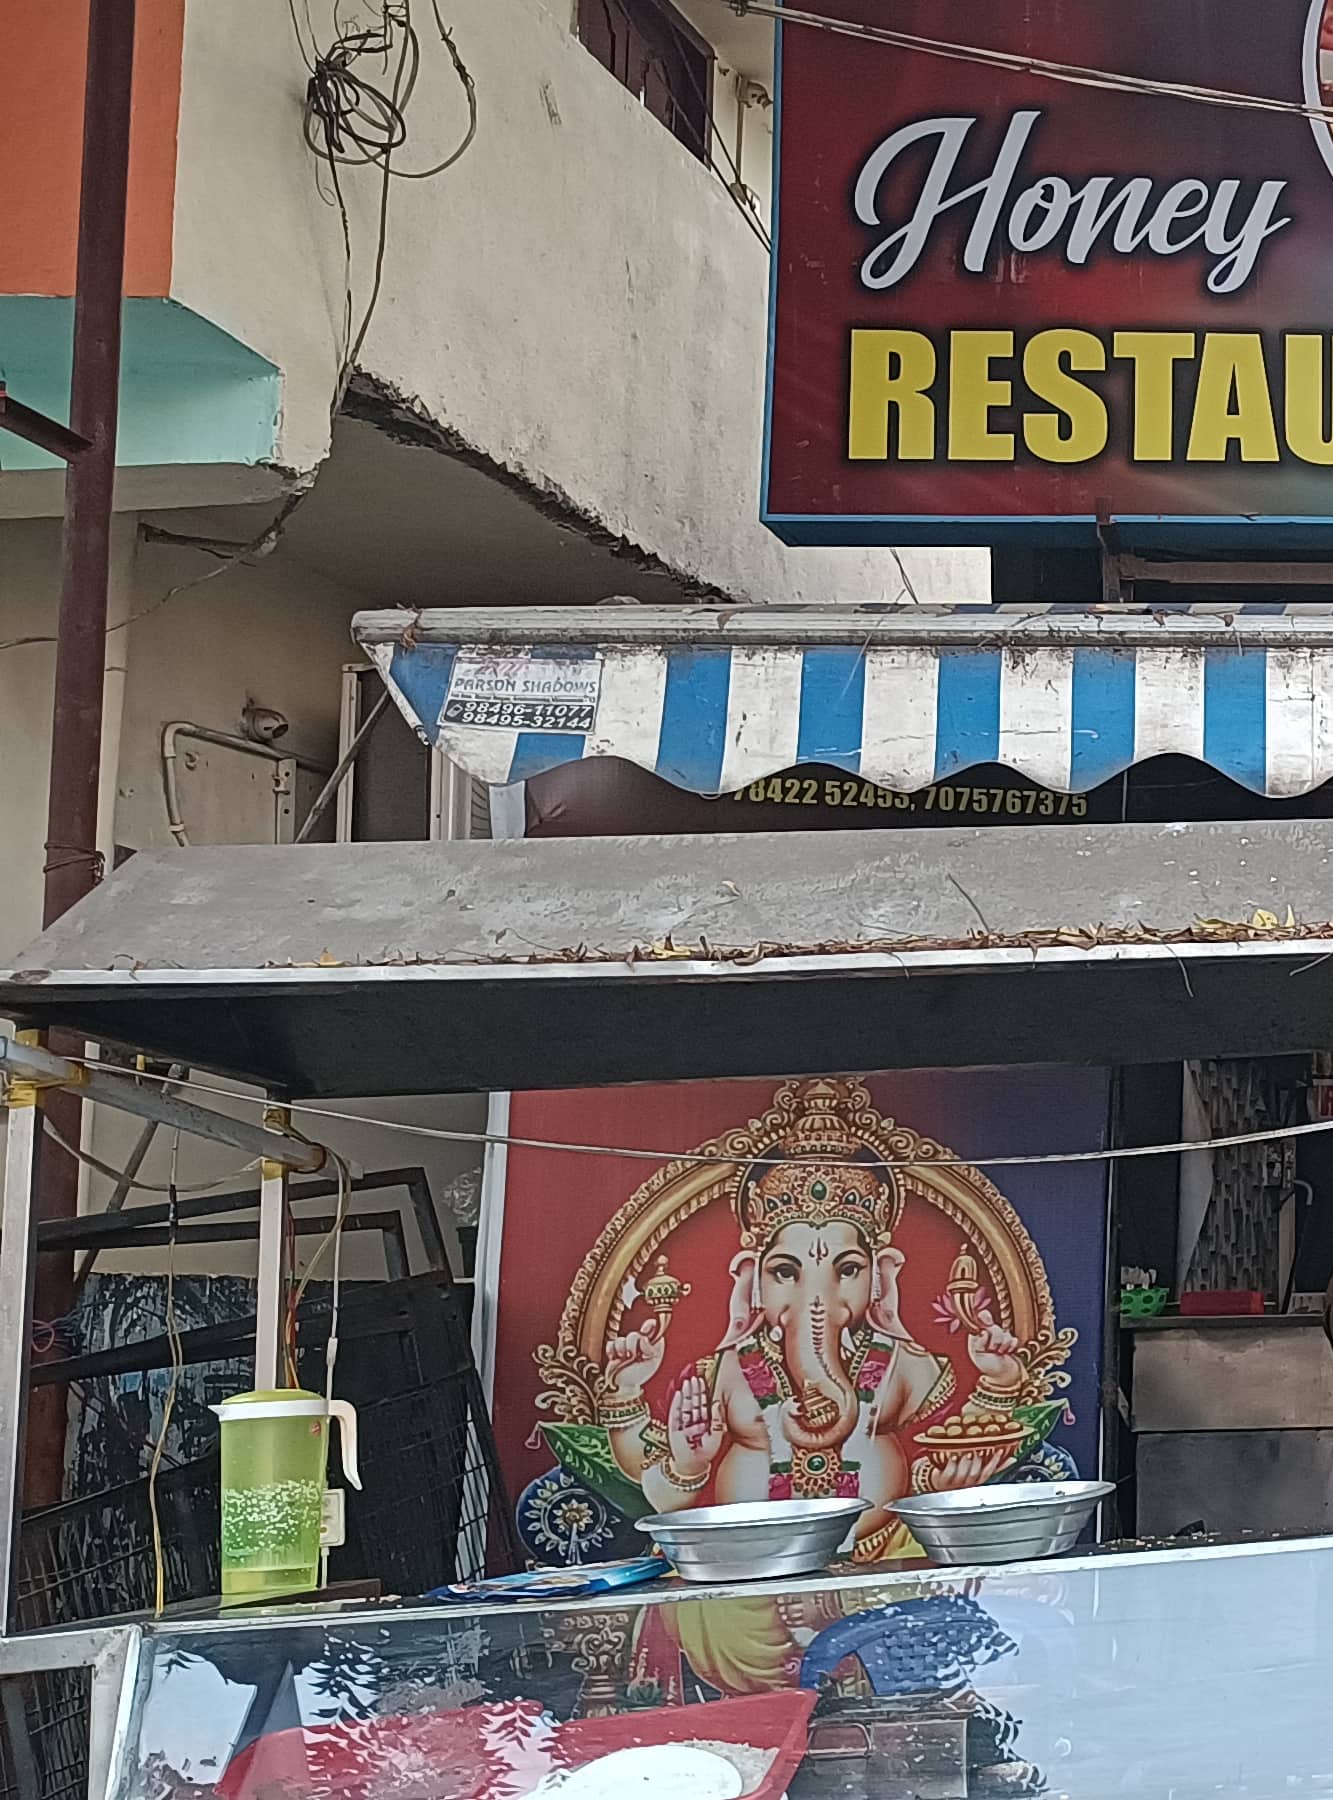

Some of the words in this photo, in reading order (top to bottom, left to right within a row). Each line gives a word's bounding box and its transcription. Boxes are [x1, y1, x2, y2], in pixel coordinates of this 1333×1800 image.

[853, 110, 1291, 294] Honey
[454, 678, 516, 693] PARSON
[522, 680, 596, 694] SHADOWS
[464, 701, 592, 717] 98496-11077
[462, 712, 591, 729] 98495-32144
[925, 786, 1088, 816] 7075767375
